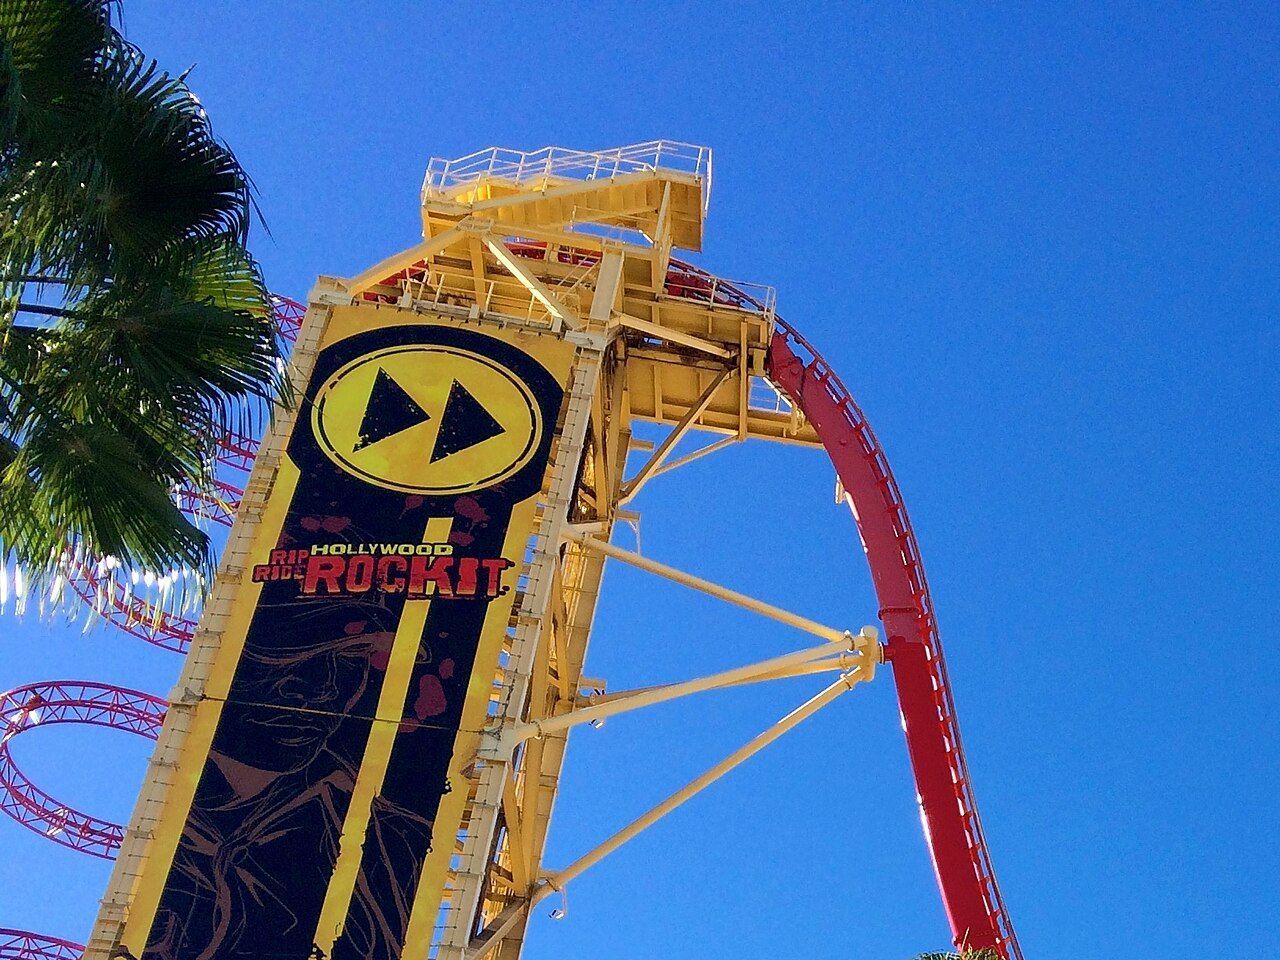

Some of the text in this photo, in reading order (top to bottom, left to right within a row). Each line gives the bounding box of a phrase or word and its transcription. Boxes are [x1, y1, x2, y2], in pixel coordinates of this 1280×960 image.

[271, 549, 310, 565] RIP
[310, 543, 454, 556] HOLLYWOOD
[254, 565, 306, 581] RIDE
[303, 555, 509, 597] ROCKIT
